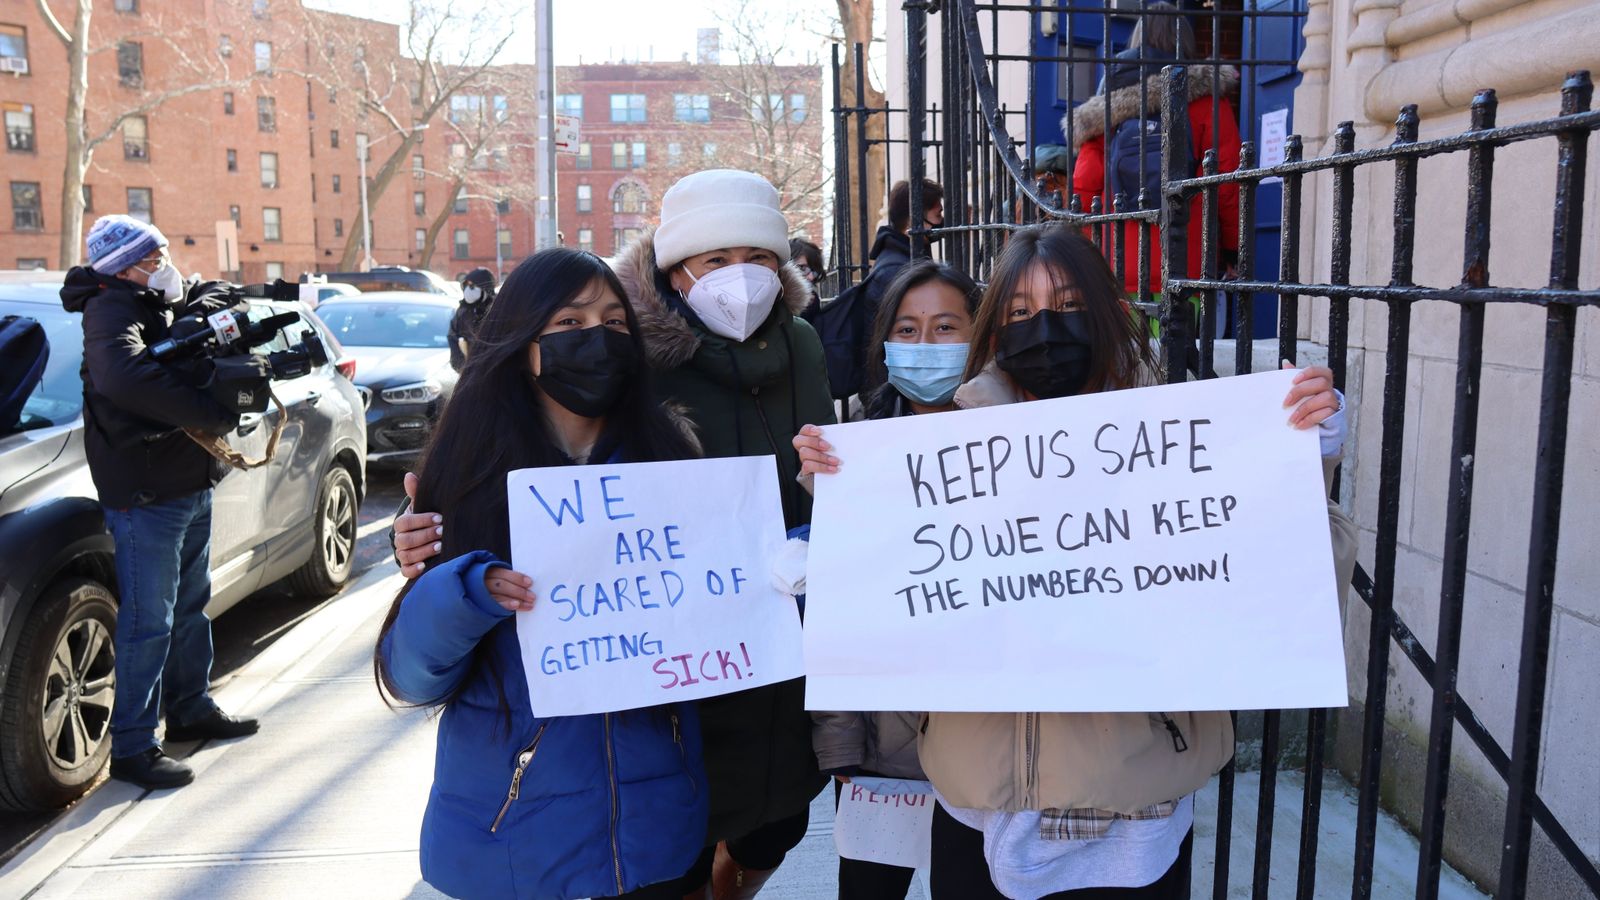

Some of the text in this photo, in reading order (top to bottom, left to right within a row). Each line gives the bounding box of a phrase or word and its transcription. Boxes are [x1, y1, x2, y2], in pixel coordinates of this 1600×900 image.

[906, 419, 1212, 508] KEEP US SAFE
[529, 476, 634, 526] WE
[616, 525, 685, 564] ARE
[908, 494, 1237, 575] SO WE CAN KEEP
[551, 568, 747, 621] SCARED OF
[895, 553, 1231, 617] THE NUMBERS DOWN!
[541, 632, 663, 675] GETTING
[652, 642, 753, 689] SICK!
